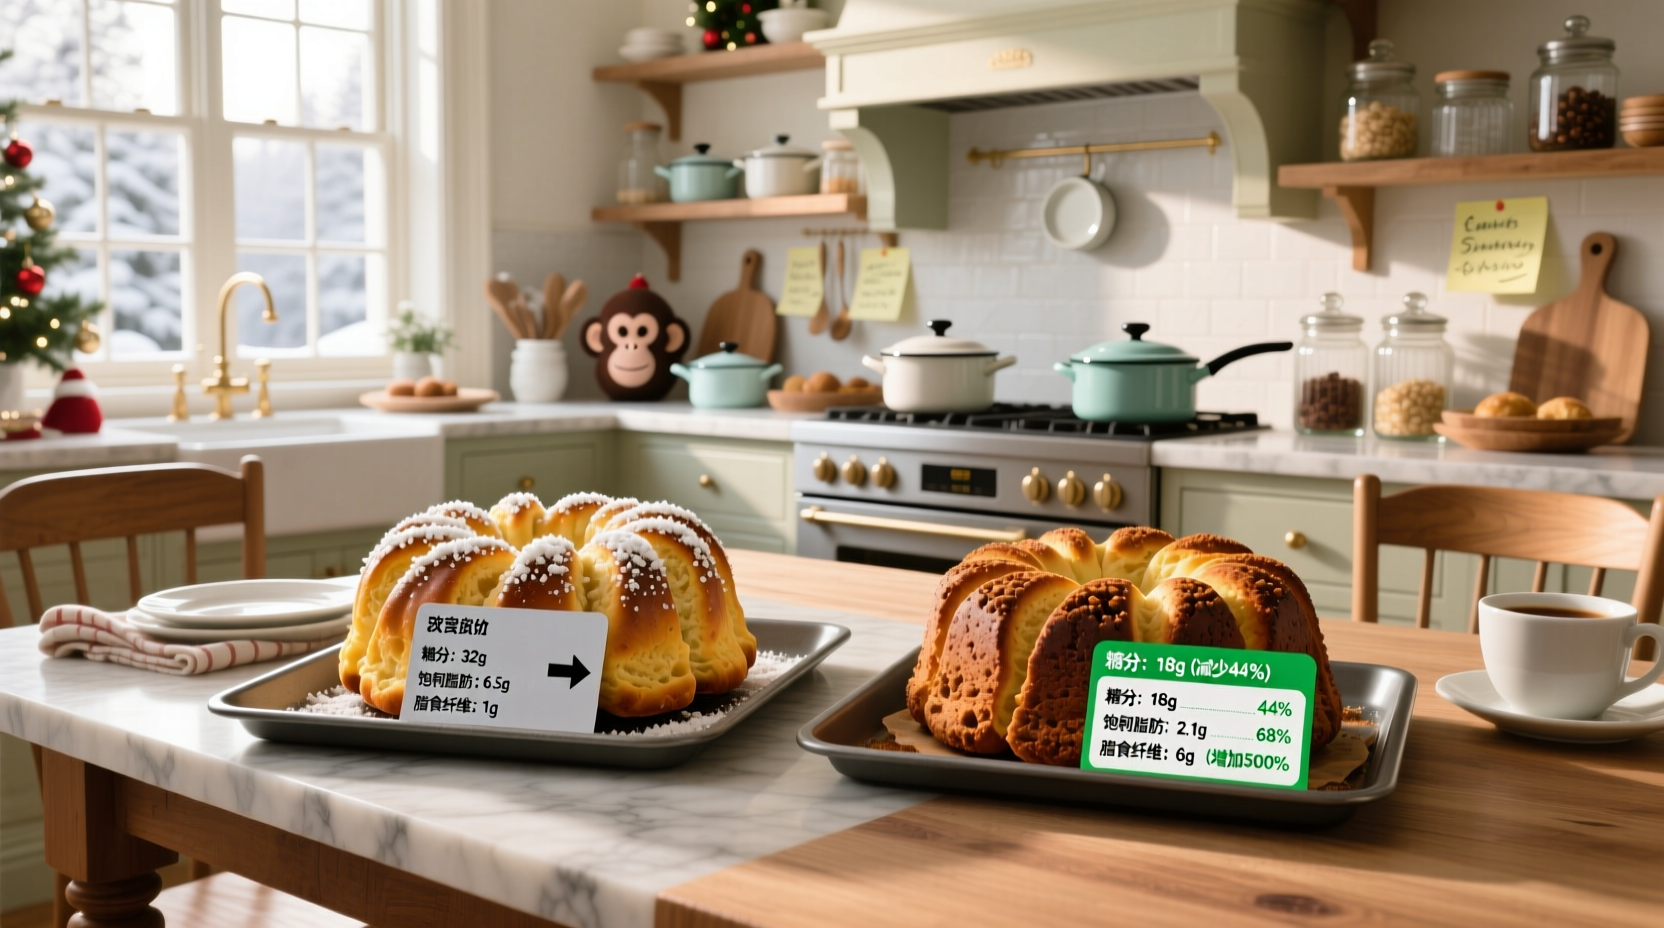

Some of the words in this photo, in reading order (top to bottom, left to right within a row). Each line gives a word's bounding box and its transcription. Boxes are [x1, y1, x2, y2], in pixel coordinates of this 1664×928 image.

[461, 649, 487, 667] 32g
[1157, 656, 1186, 677] 18g
[482, 700, 499, 718] 1g
[1151, 692, 1178, 711] 18g
[1257, 699, 1292, 717] 44%
[1176, 721, 1207, 740] 2.1g
[1256, 727, 1291, 744] 68%
[1175, 747, 1195, 766] 6g
